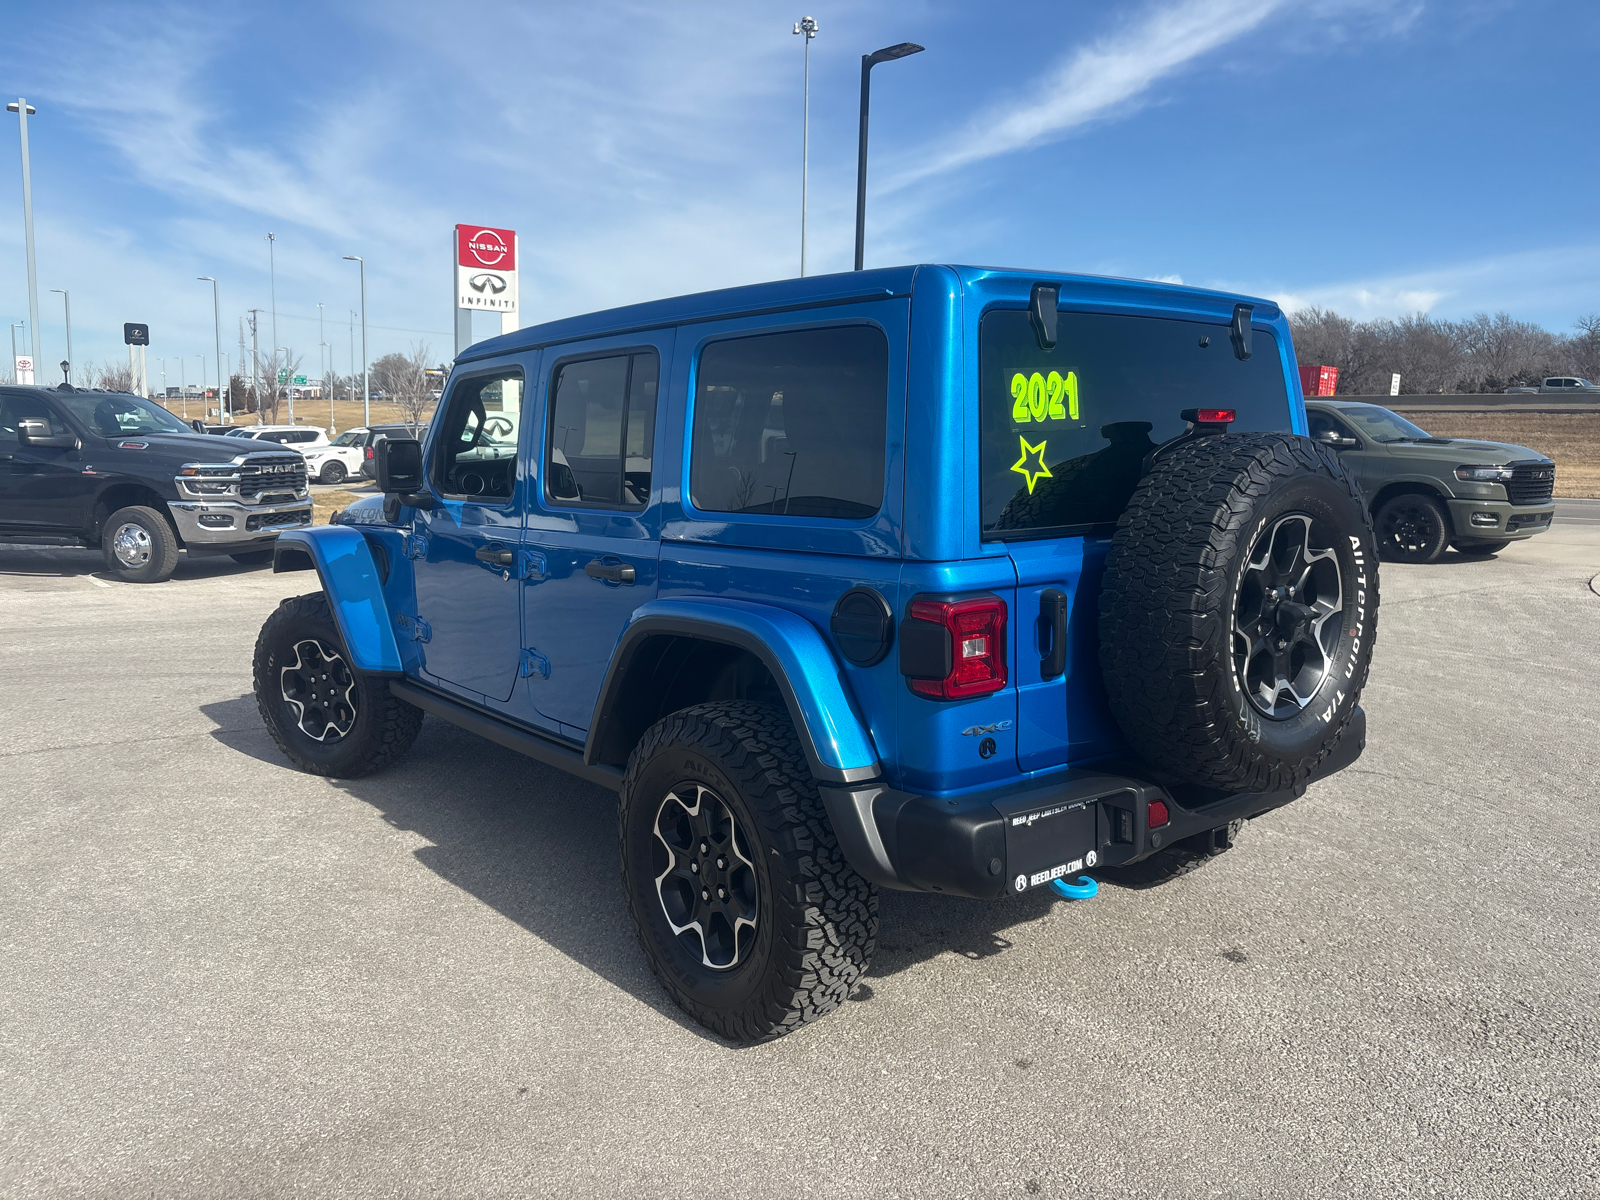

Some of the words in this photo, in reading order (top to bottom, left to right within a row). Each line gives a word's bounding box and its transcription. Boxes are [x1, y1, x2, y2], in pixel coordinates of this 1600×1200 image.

[468, 242, 507, 253] NISSAN
[461, 296, 515, 308] INFINITI
[1011, 371, 1079, 423] 2021
[1344, 534, 1366, 679] All-Terrain
[1321, 690, 1344, 724] T/A
[1012, 816, 1026, 826] REED
[1028, 811, 1041, 821] JEEP
[1031, 859, 1083, 886] REEDJEEP.COM
